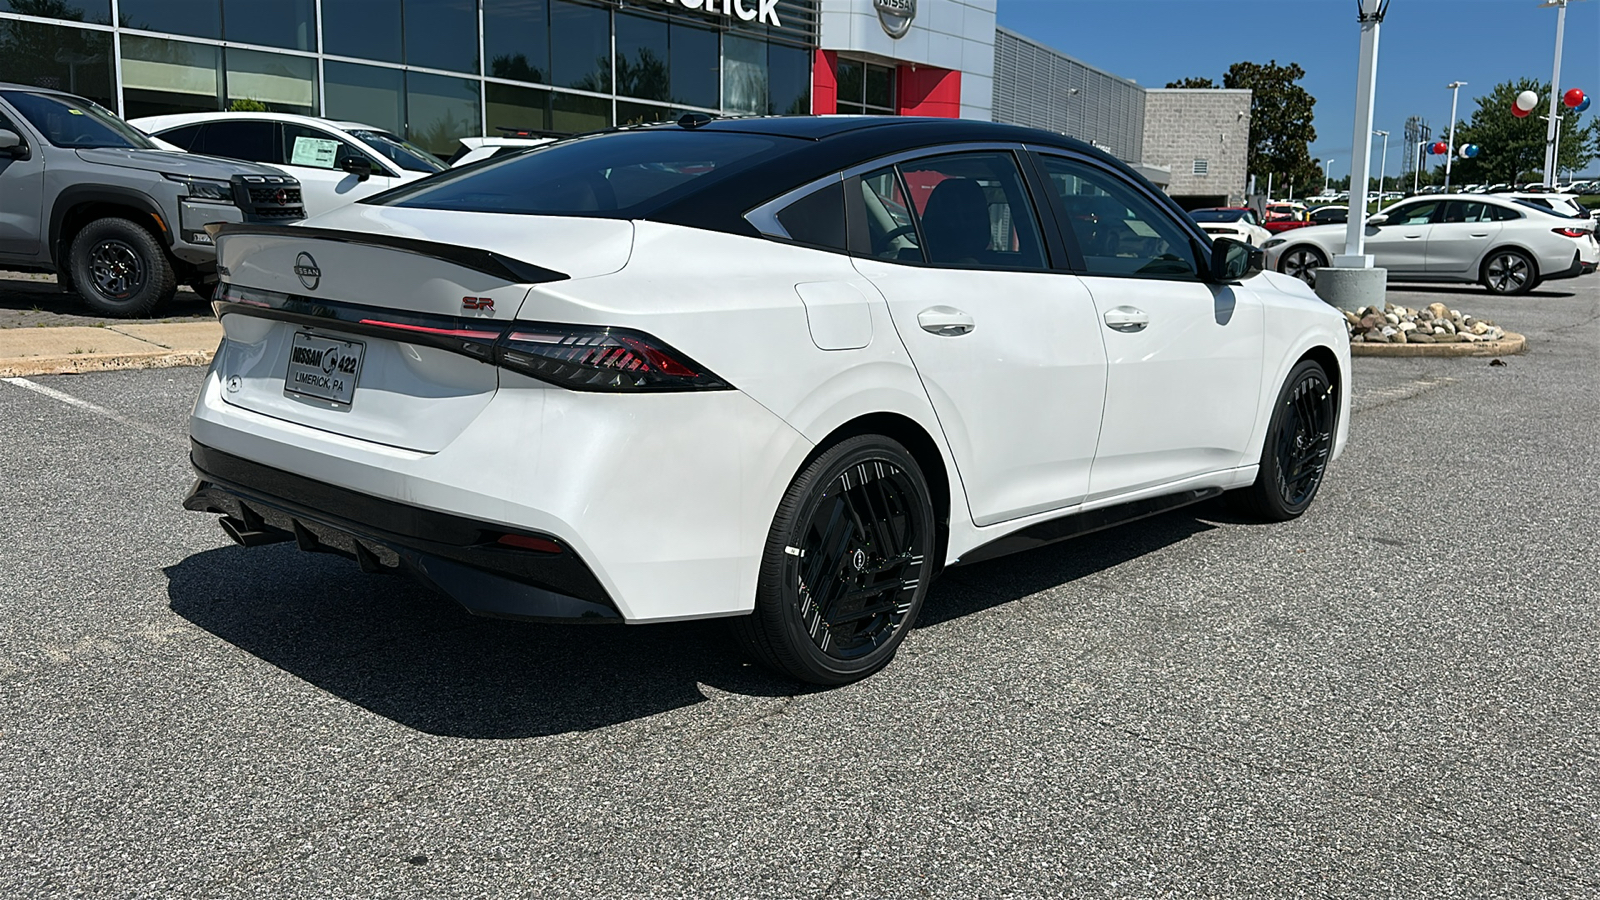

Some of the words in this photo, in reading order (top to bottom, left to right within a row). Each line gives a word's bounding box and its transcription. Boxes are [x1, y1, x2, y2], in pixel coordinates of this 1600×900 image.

[296, 266, 319, 277] SSAN
[462, 296, 496, 311] SR
[292, 346, 324, 368] NISSAN
[338, 355, 357, 374] 422
[295, 371, 331, 390] LIMERICK,
[332, 380, 344, 391] PA
